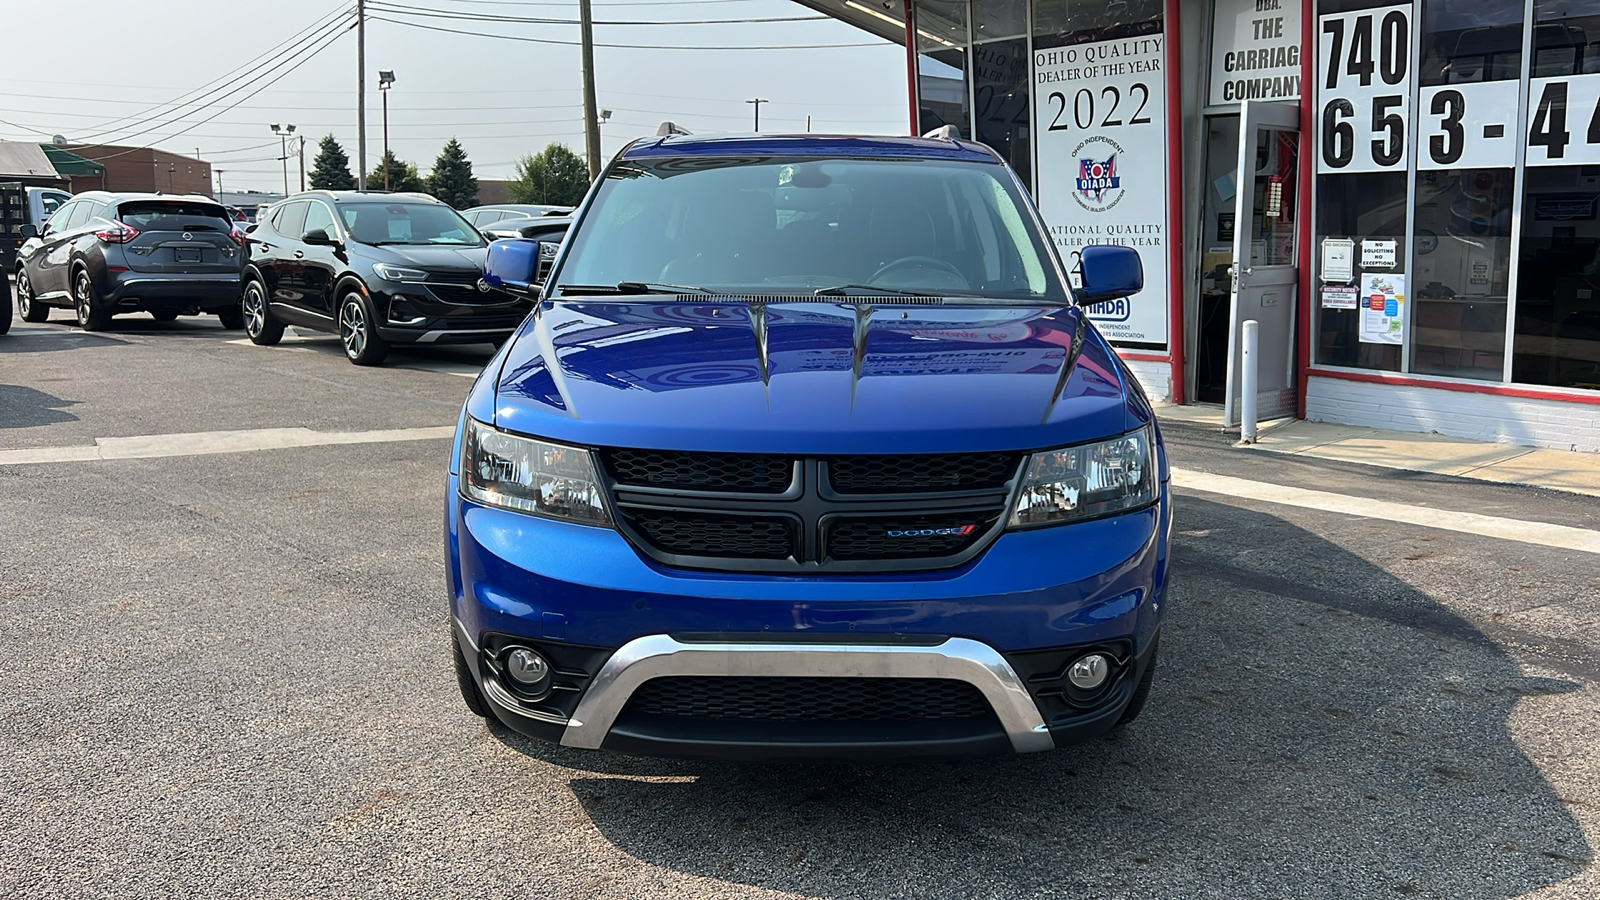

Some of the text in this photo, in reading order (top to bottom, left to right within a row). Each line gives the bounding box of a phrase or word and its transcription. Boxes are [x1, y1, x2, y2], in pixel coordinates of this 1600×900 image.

[1252, 17, 1283, 40] THE
[1036, 38, 1162, 67] OHIO QUALITY
[1224, 45, 1302, 72] CARRIAG
[1323, 10, 1408, 89] 740
[1038, 68, 1081, 83] DEALER
[1083, 66, 1099, 78] OF
[1101, 63, 1125, 76] THE
[1128, 59, 1160, 73] YEAR
[1048, 83, 1151, 131] 2022
[1071, 135, 1124, 157] OHIO INDEPENDENT
[1081, 178, 1112, 189] OIADA
[1106, 189, 1126, 210] ASSOCIATION
[1050, 224, 1162, 235] ATIONAL QUALITY
[1087, 237, 1100, 246] OF
[1105, 237, 1126, 246] THE
[1131, 237, 1160, 246] YEAR
[887, 527, 964, 537] DODGE
